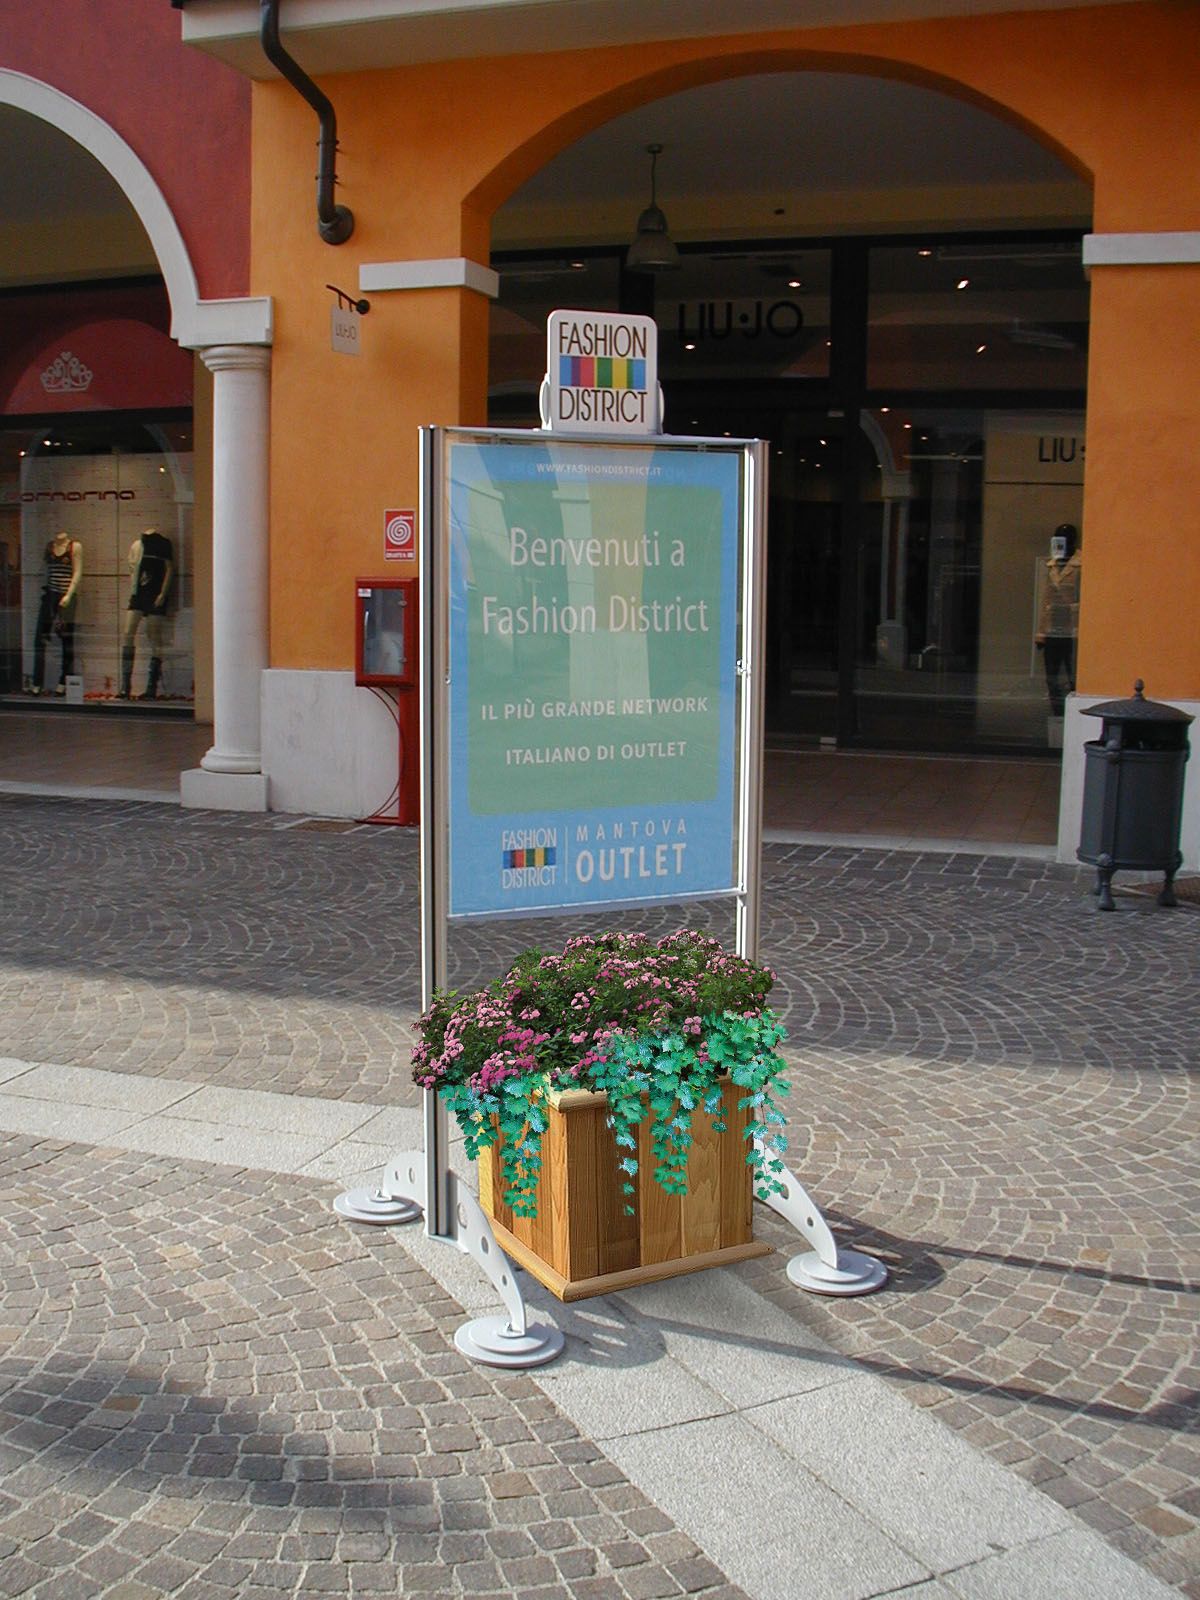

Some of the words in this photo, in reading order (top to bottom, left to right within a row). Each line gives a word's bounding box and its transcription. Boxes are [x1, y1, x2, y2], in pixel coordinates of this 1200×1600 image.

[559, 322, 647, 358] FASHION
[559, 388, 648, 423] DISTRICT
[536, 463, 662, 477] WWW.FASHIONDISTRICT.IT
[509, 527, 661, 568] Benvenuti
[670, 540, 685, 566] a
[482, 596, 597, 635] Fashion
[609, 595, 709, 633] District
[481, 705, 498, 721] IL
[504, 698, 536, 719] PIÙ
[541, 700, 616, 718] GRANDE
[621, 697, 708, 716] NETWORK
[506, 746, 590, 765] ITALIANO
[596, 744, 614, 761] DI
[620, 741, 687, 759] OUTLET
[502, 828, 557, 850] FASHION
[576, 818, 687, 842] MANTOVA
[575, 843, 687, 883] OUTLET
[502, 865, 557, 889] DISTRICT
